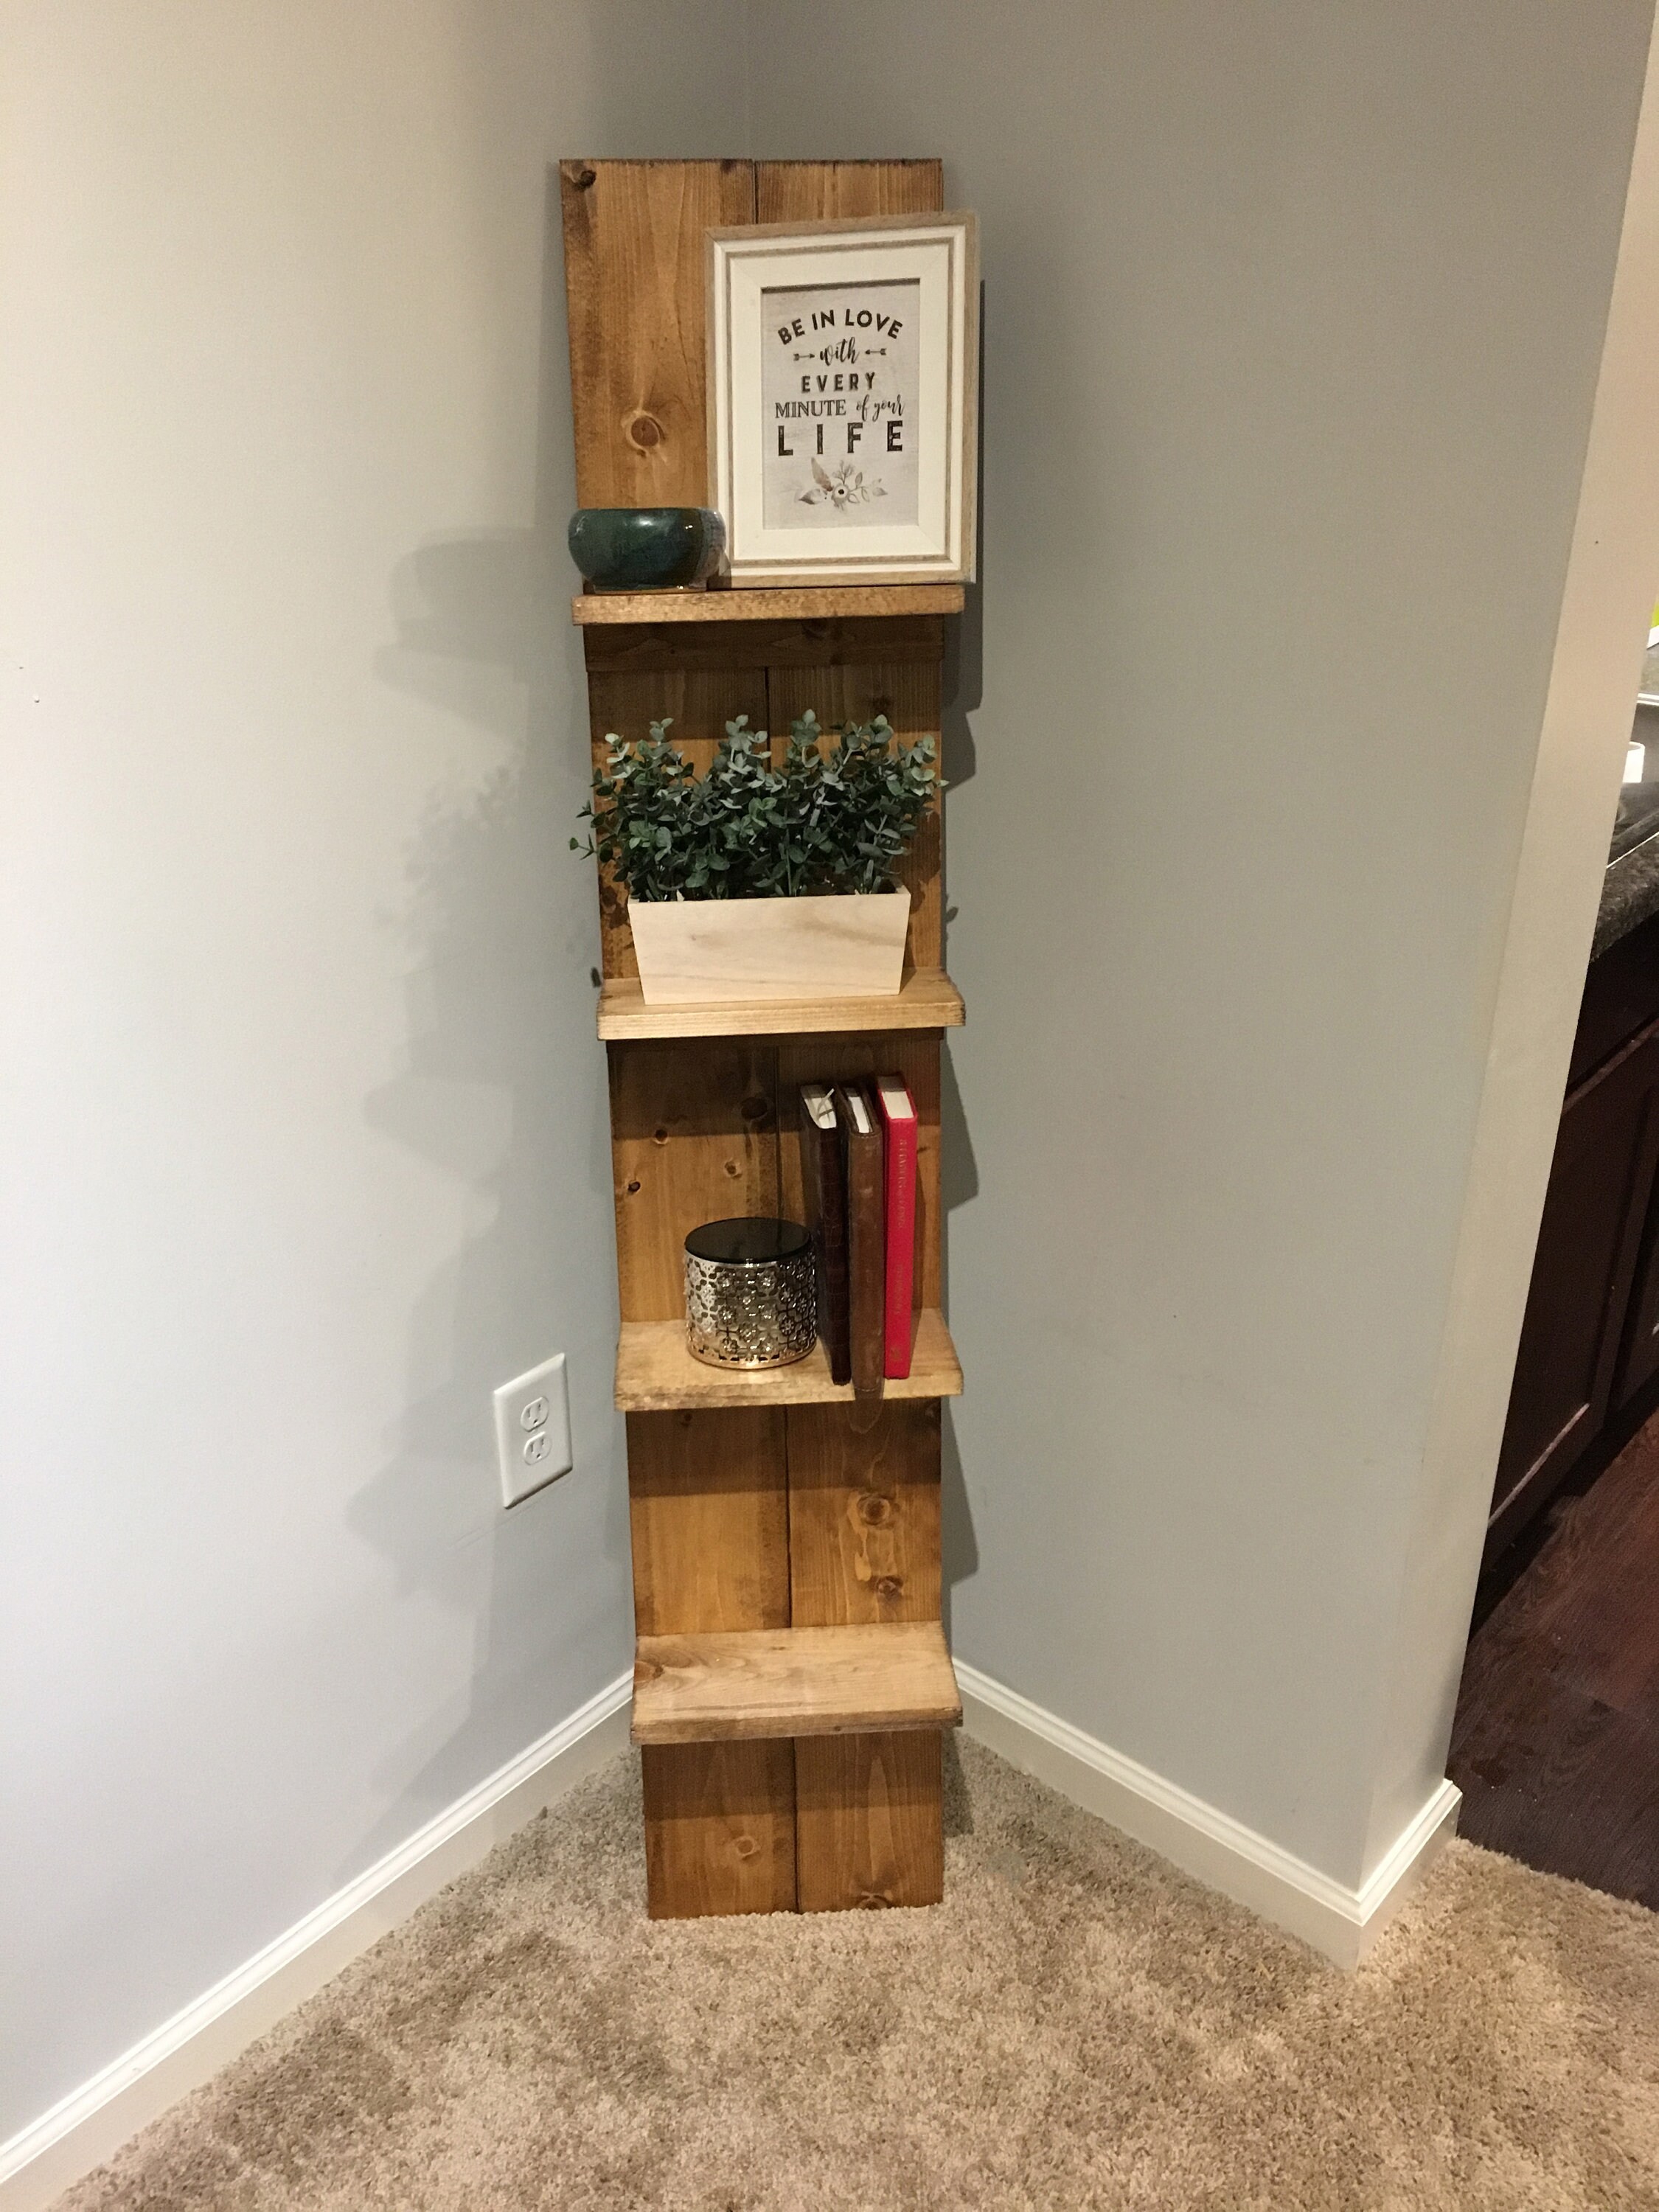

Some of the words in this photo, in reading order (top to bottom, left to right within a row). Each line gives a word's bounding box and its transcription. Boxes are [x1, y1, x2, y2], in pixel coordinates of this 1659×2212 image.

[778, 319, 805, 345] BE
[812, 310, 835, 330] IN
[845, 309, 902, 339] LOVE
[820, 337, 858, 366] with
[801, 372, 875, 393] EVERY
[775, 400, 846, 418] MINUTE
[856, 394, 869, 421] of
[874, 394, 904, 422] your
[778, 420, 902, 456] LIFE
